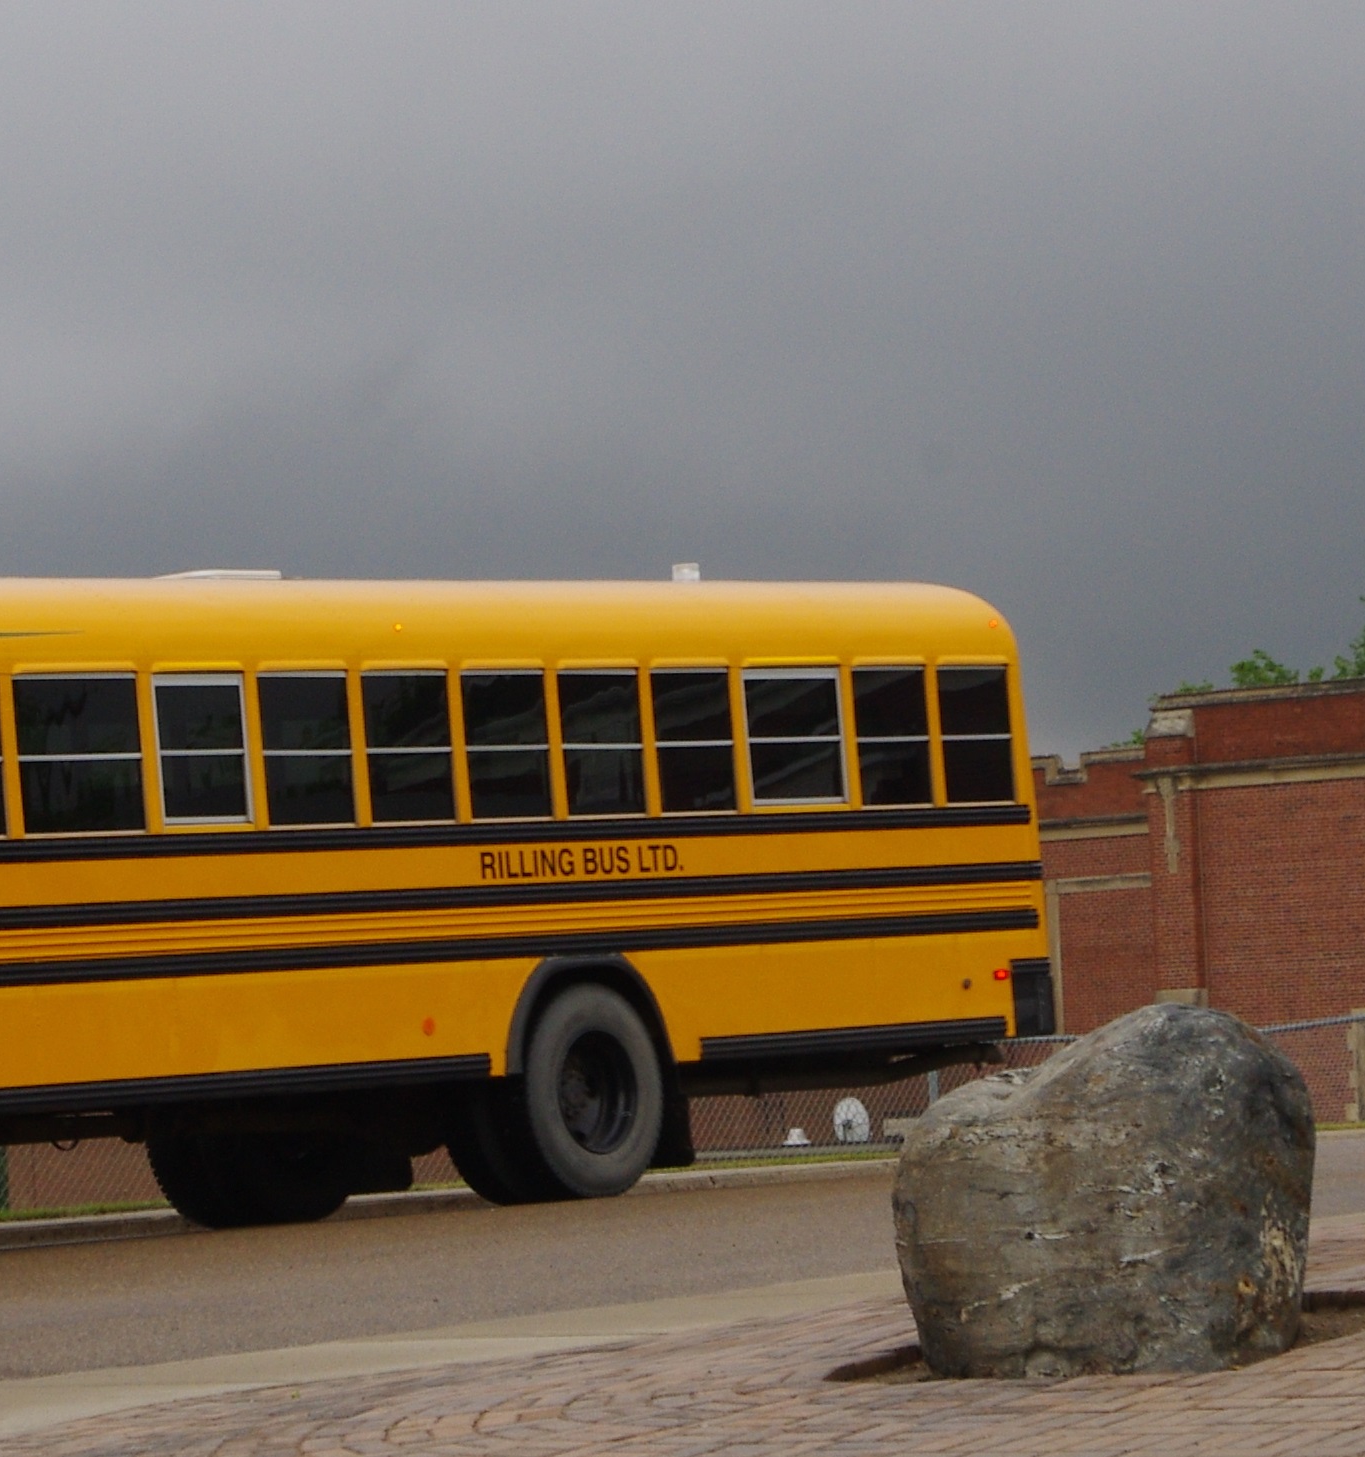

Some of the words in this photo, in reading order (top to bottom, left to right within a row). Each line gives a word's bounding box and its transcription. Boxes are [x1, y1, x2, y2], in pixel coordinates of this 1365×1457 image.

[480, 848, 574, 879] RILLING
[583, 846, 630, 875] BUS
[638, 844, 685, 872] LTD.
